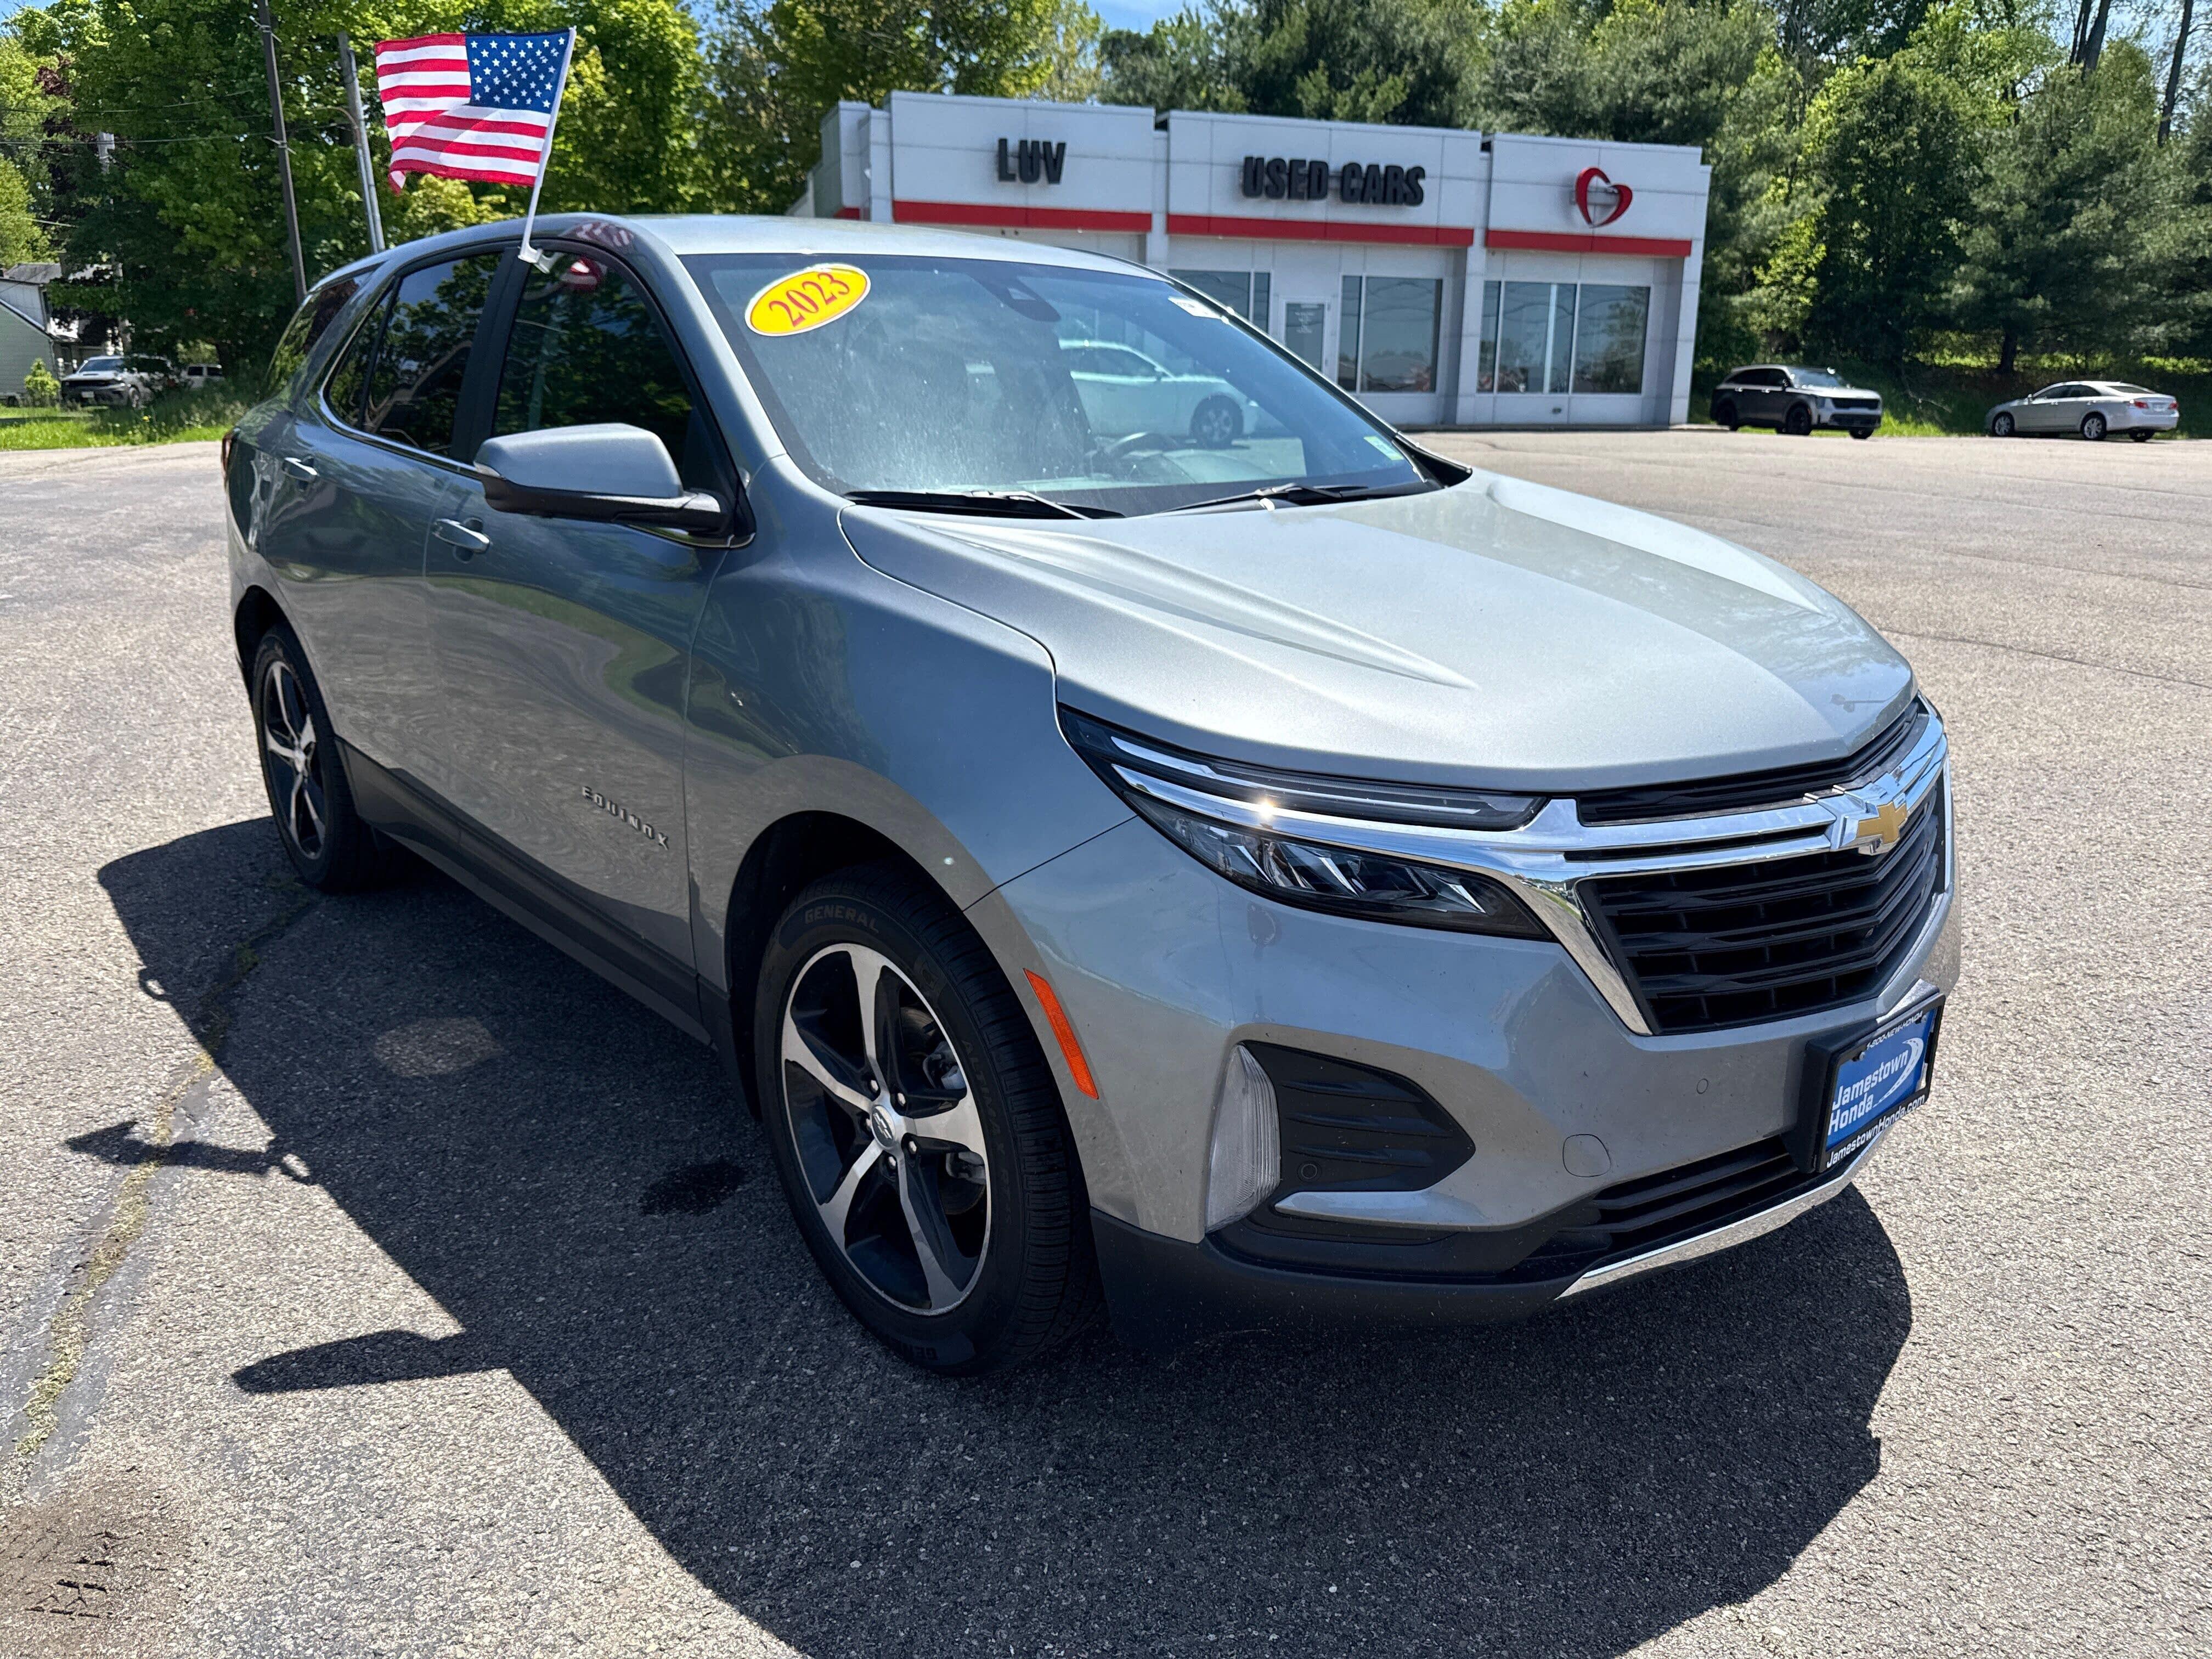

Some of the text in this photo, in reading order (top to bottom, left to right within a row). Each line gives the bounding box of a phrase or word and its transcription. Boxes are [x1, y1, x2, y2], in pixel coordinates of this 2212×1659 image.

[998, 138, 1066, 184] LUV
[1242, 156, 1426, 206] USED CARS
[769, 272, 850, 328] 2023
[582, 786, 669, 850] EQUINOX
[804, 904, 880, 934] GENERAL
[1832, 1049, 1909, 1111] Jamestown
[1826, 1094, 1926, 1169] JamestownHonda.com
[1827, 1092, 1874, 1136] Honda
